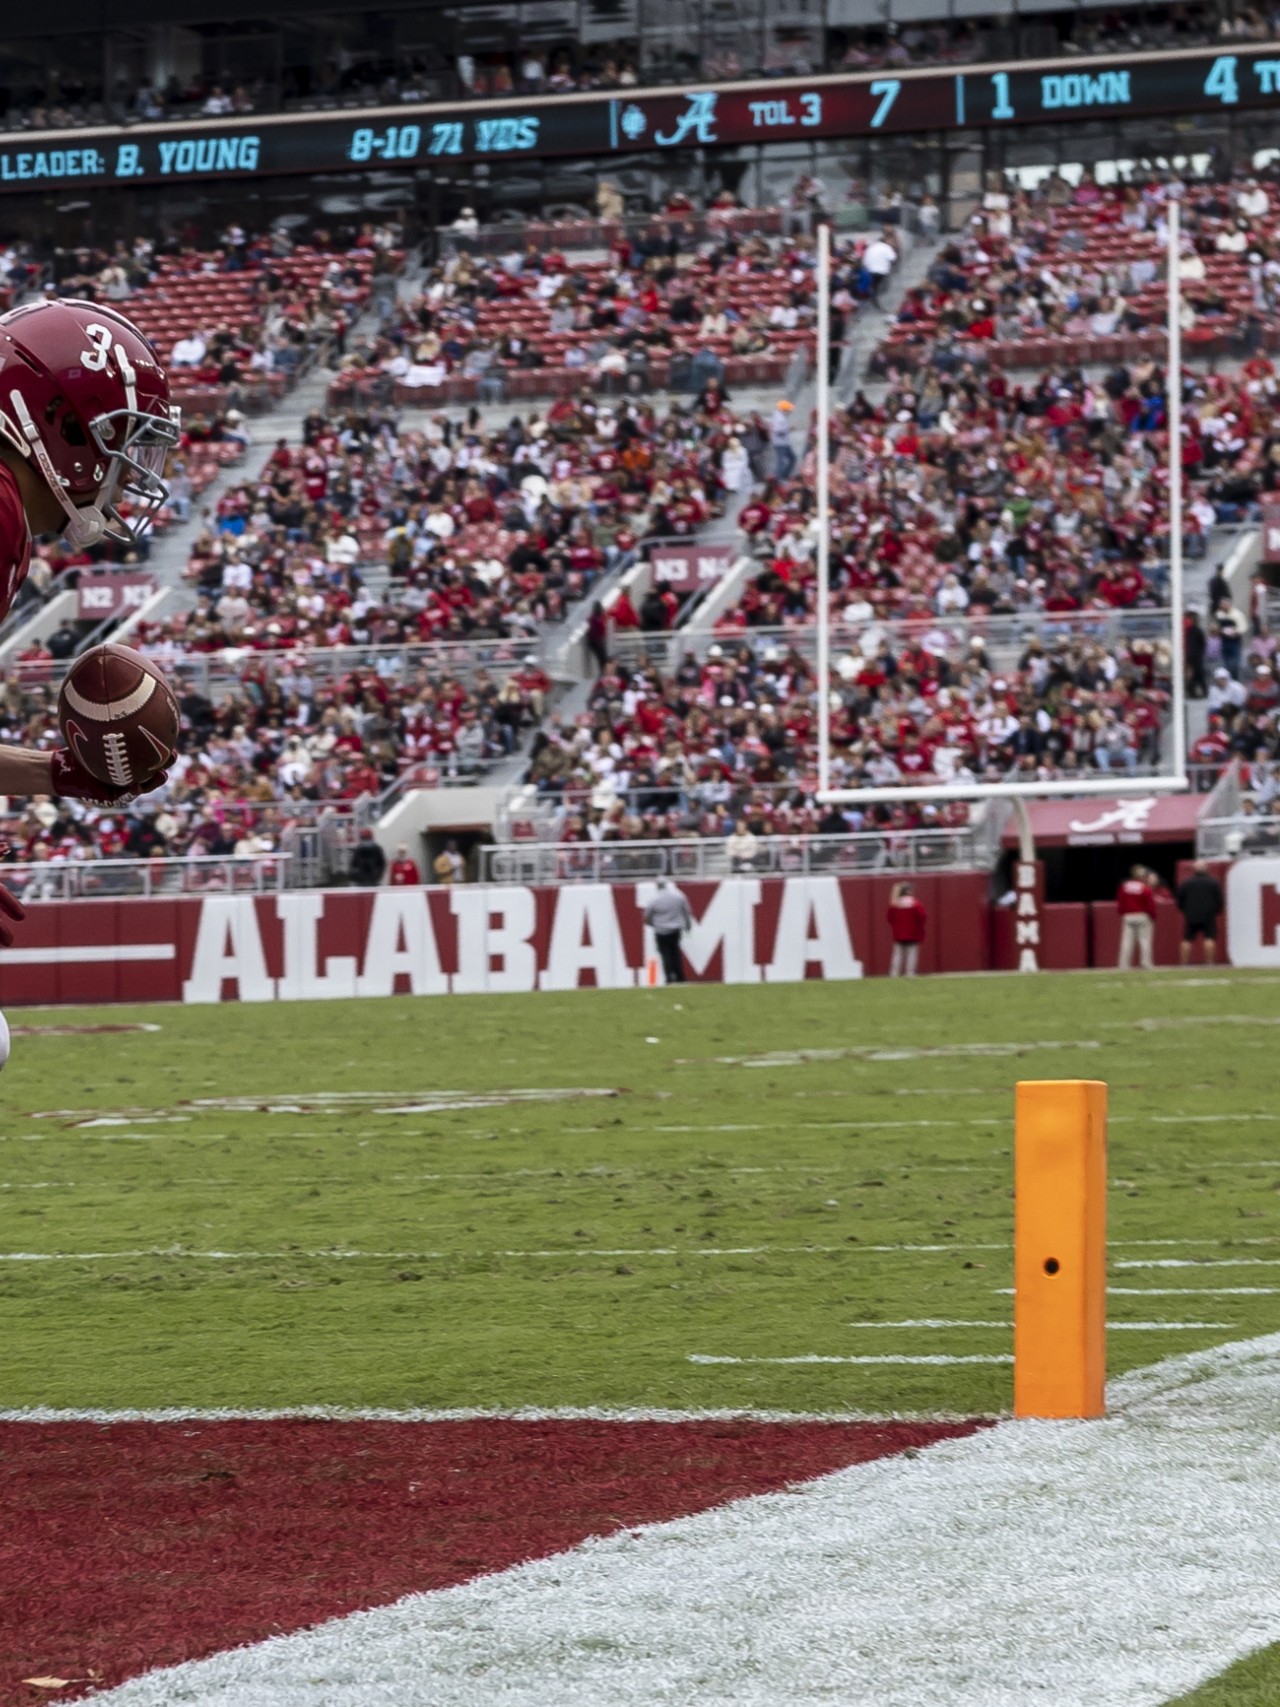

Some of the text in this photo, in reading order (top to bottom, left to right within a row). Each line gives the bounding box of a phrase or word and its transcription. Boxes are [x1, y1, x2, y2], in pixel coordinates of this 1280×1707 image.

[990, 71, 1131, 120] 1 DOWN
[1204, 57, 1238, 103] 4
[749, 101, 795, 126] TOL
[800, 93, 822, 126] 3
[869, 80, 901, 127] 7
[1, 149, 105, 180] LEADER:
[115, 145, 145, 177] B.
[158, 136, 260, 174] YOUNG
[349, 125, 419, 162] 8-10
[427, 122, 464, 156] 71
[80, 323, 112, 372] 3
[183, 876, 863, 1004] ALABAMA
